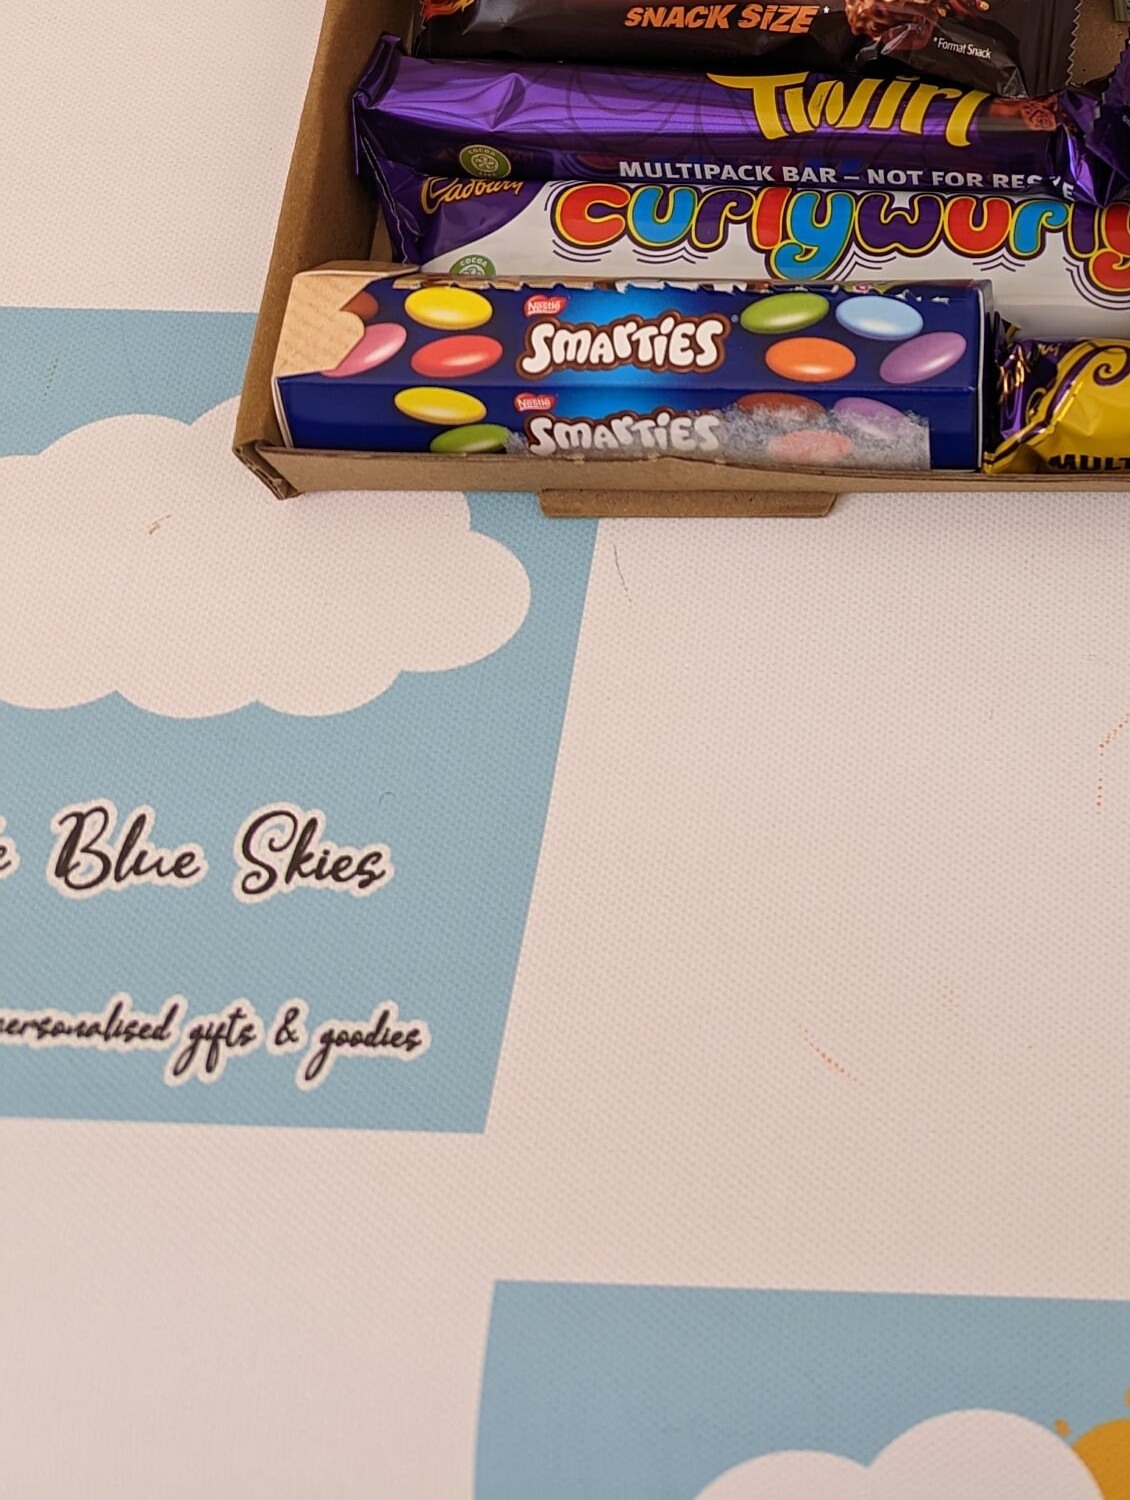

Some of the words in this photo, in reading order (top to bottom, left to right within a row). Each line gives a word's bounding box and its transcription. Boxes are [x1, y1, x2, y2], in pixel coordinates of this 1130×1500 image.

[624, 4, 737, 29] SNACK
[967, 42, 992, 60] Snack
[706, 71, 994, 148] Twirl
[618, 161, 774, 183] MULTIPACK
[782, 165, 837, 184] BAR
[867, 168, 924, 186] NOT
[931, 170, 984, 188] FOR
[55, 806, 201, 890] Blue
[241, 810, 387, 895] Skies
[173, 1006, 257, 1077] gifts
[275, 1006, 301, 1045] &
[304, 1009, 423, 1081] goodies
